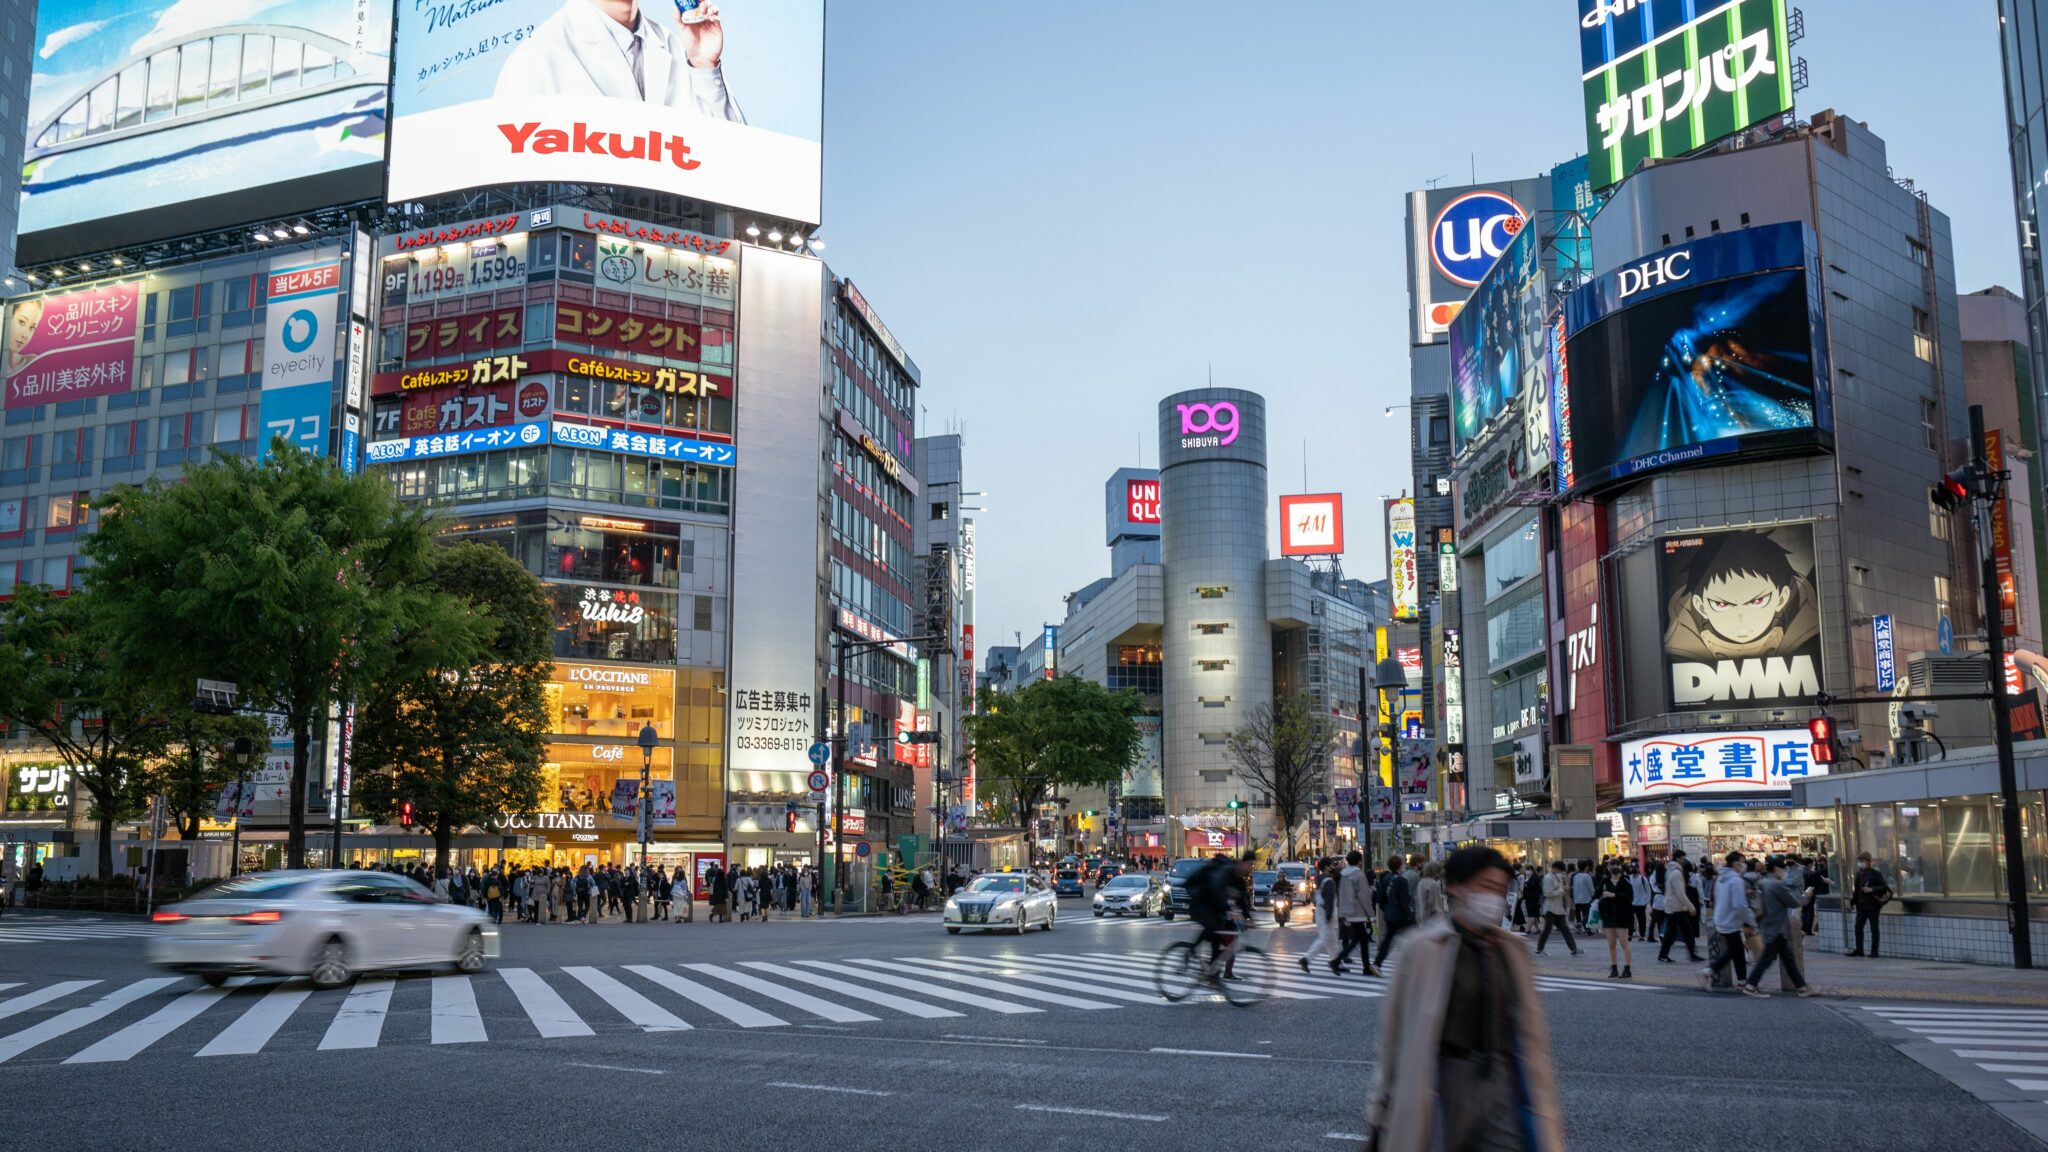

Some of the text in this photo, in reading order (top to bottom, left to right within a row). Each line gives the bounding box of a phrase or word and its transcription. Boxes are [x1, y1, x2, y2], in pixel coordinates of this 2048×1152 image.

[1596, 28, 1776, 150] サロンパス
[496, 121, 702, 171] Yakult
[395, 213, 518, 250] しゃぶしゃぶバイキング
[584, 211, 732, 255] しゃぶしゃぶバイキング
[275, 268, 333, 293] 当ビル5F
[385, 272, 407, 291] 9F
[645, 256, 730, 295] しゃぶ葉
[1618, 250, 1690, 298] DHC
[66, 294, 133, 321] 品川スキン
[64, 315, 124, 341] クリニック
[408, 312, 521, 354] プライス
[557, 307, 697, 352] コンタクト
[23, 360, 126, 397] 品川美容外科
[271, 354, 326, 377] eyecity
[472, 355, 528, 385] ガスト
[654, 367, 718, 398] ガスト
[375, 409, 401, 431] 7F
[439, 394, 509, 432] ガスト
[1177, 401, 1240, 446] 109
[371, 442, 405, 459] AEON
[415, 428, 516, 457] 英会話イーオン
[558, 425, 732, 463] AEON 英会話イーオン
[1181, 436, 1219, 448] SHIBUYA
[1635, 445, 1704, 470] DHC Channel
[1296, 514, 1327, 534] H&M
[579, 600, 644, 624] Ushi8
[569, 667, 649, 684] L'OCCITANE
[1671, 655, 1821, 703] DMM
[736, 689, 811, 712] 広告主募集中
[737, 716, 809, 733] ツツミプロジェクト
[592, 745, 624, 761] Café
[737, 736, 809, 751] 03-3369-8151
[1628, 739, 1809, 785] 大盛堂書店
